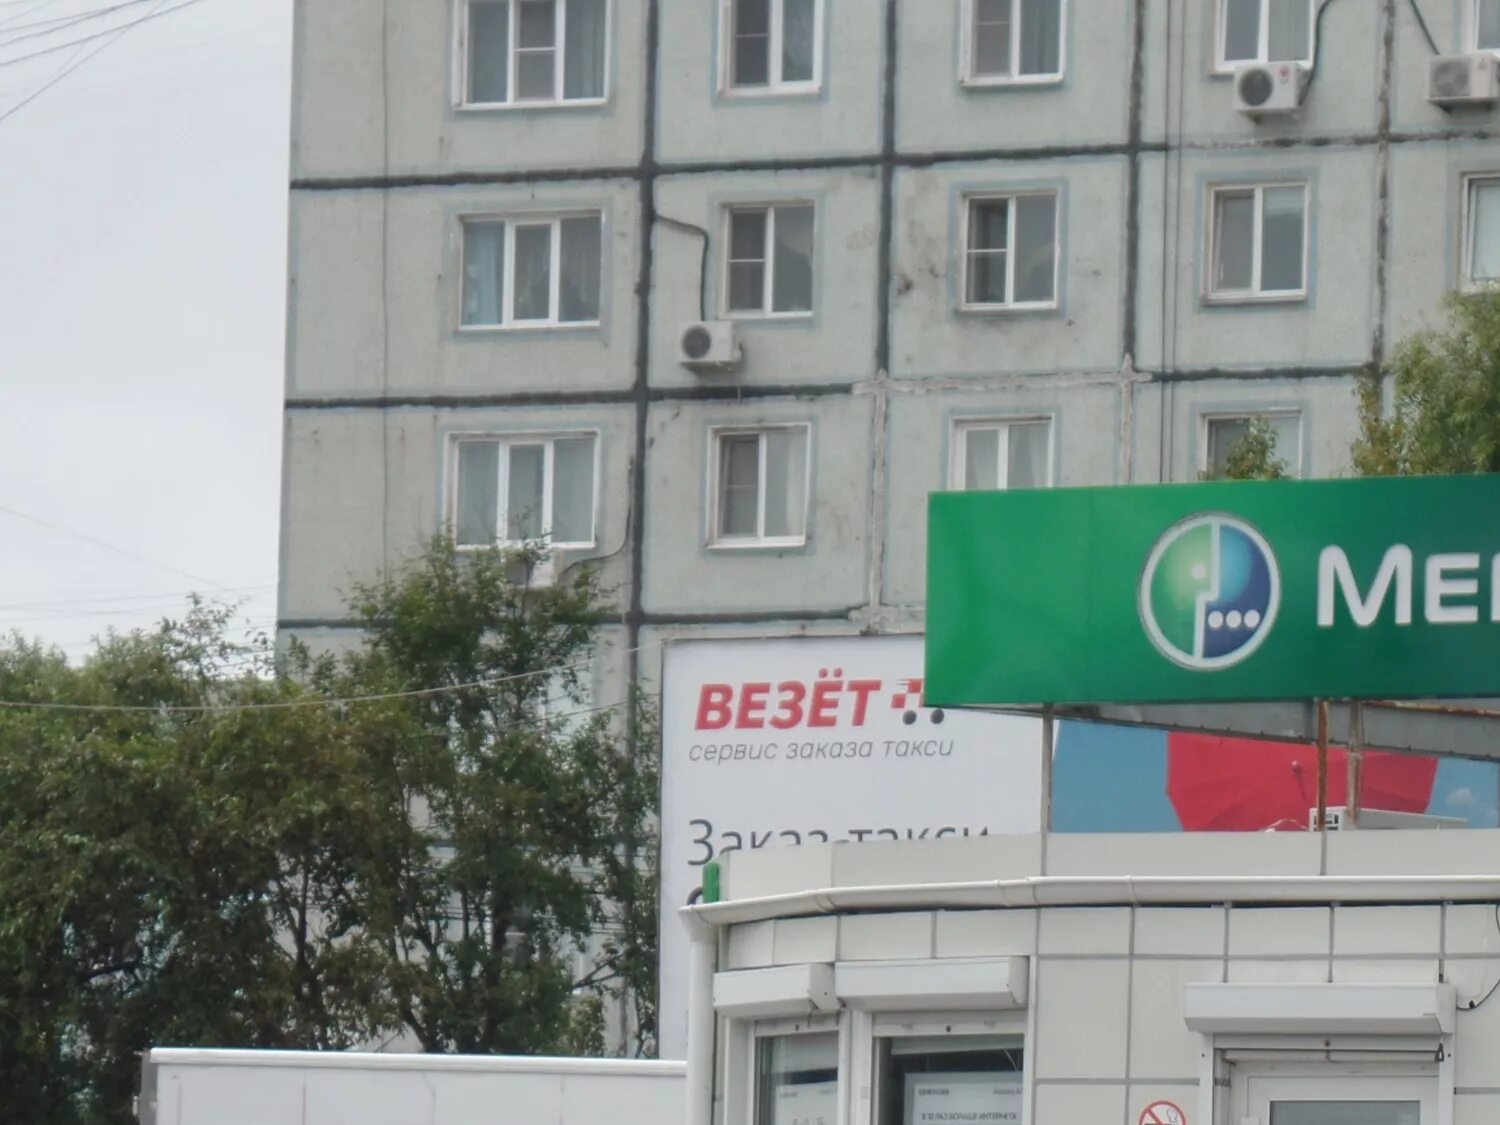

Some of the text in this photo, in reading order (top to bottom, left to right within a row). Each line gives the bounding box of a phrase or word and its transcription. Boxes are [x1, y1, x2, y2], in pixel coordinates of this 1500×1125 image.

[694, 667, 882, 731] ВЕЗЁТ
[688, 738, 954, 765] сервис заказа такси
